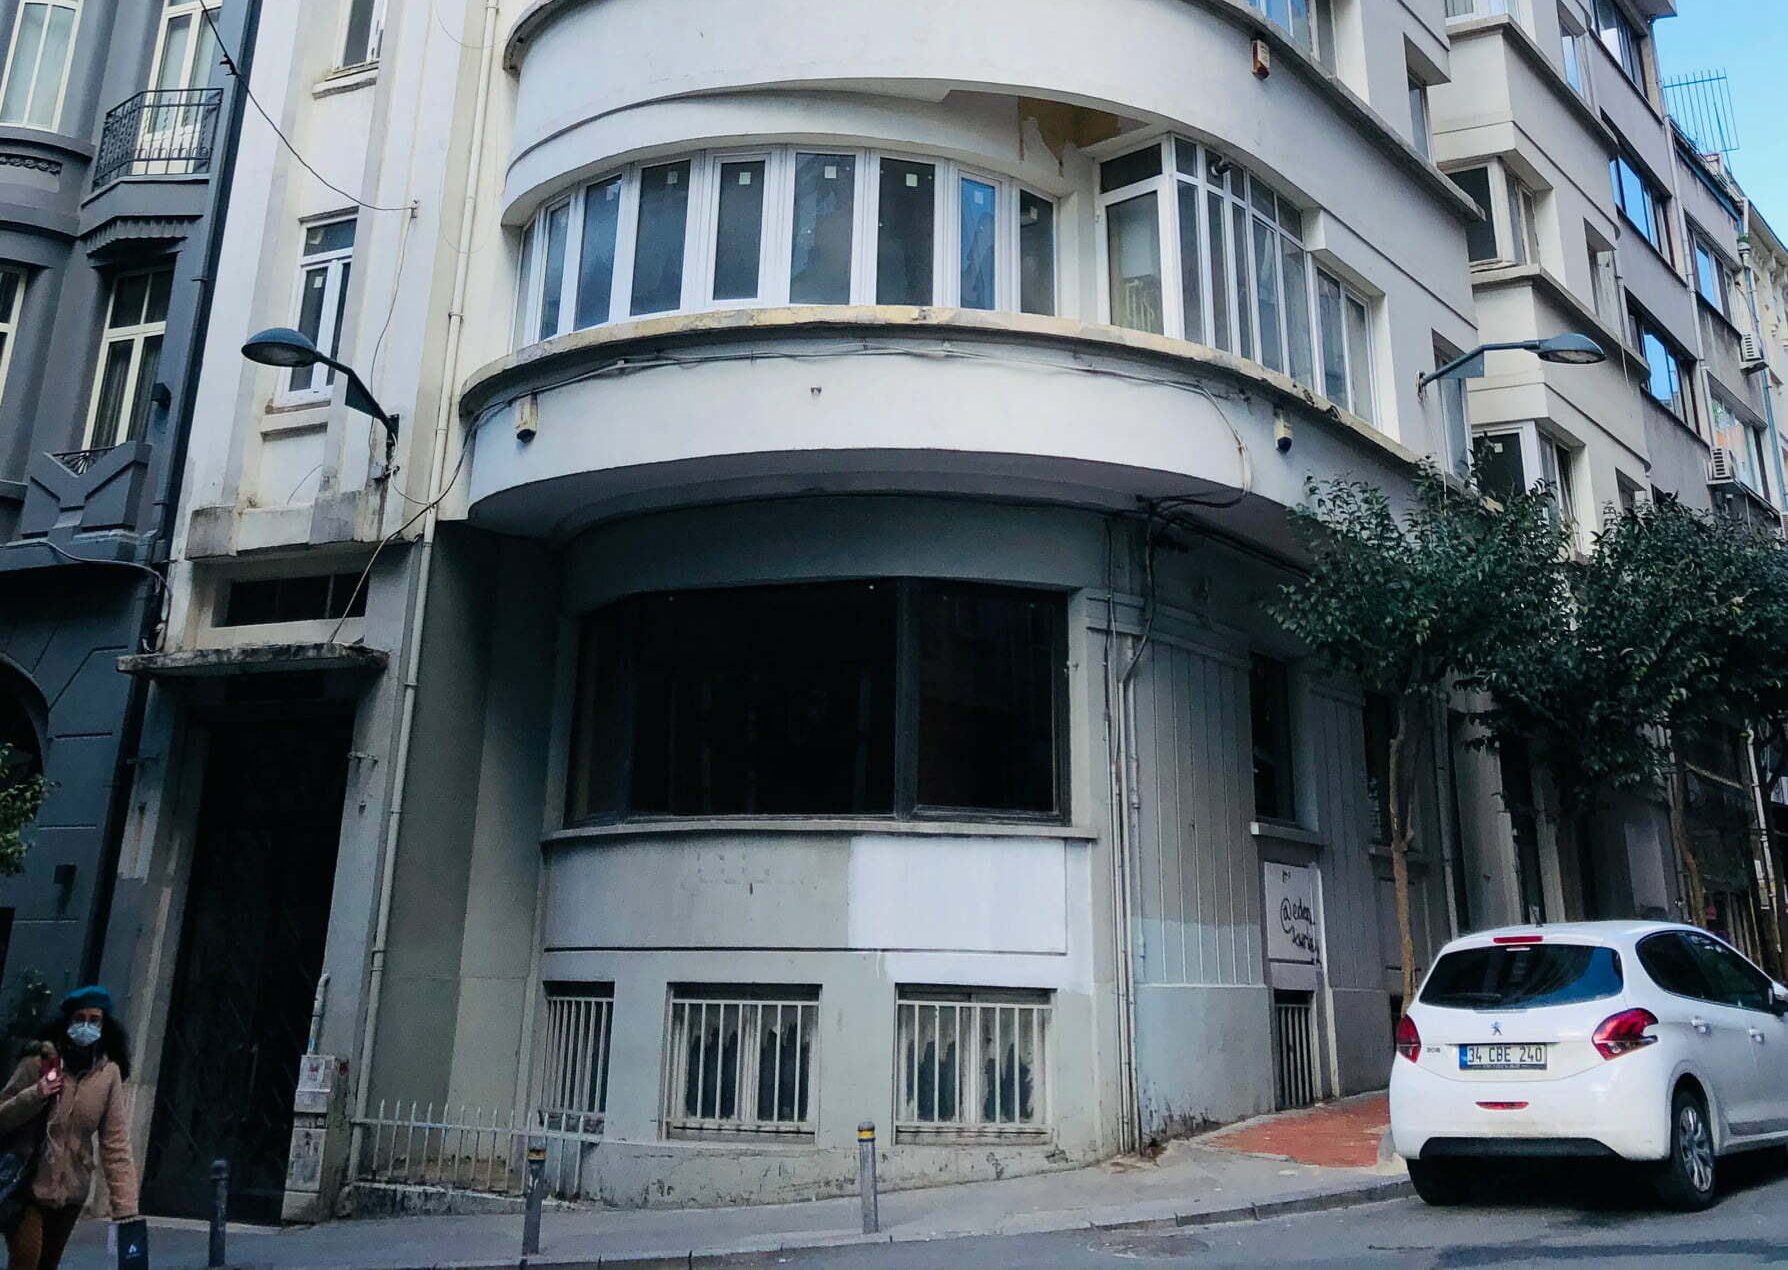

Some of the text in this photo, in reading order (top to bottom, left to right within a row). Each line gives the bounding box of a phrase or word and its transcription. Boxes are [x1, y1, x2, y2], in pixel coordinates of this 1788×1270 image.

[1468, 1046, 1542, 1063] 34 CBE 240
